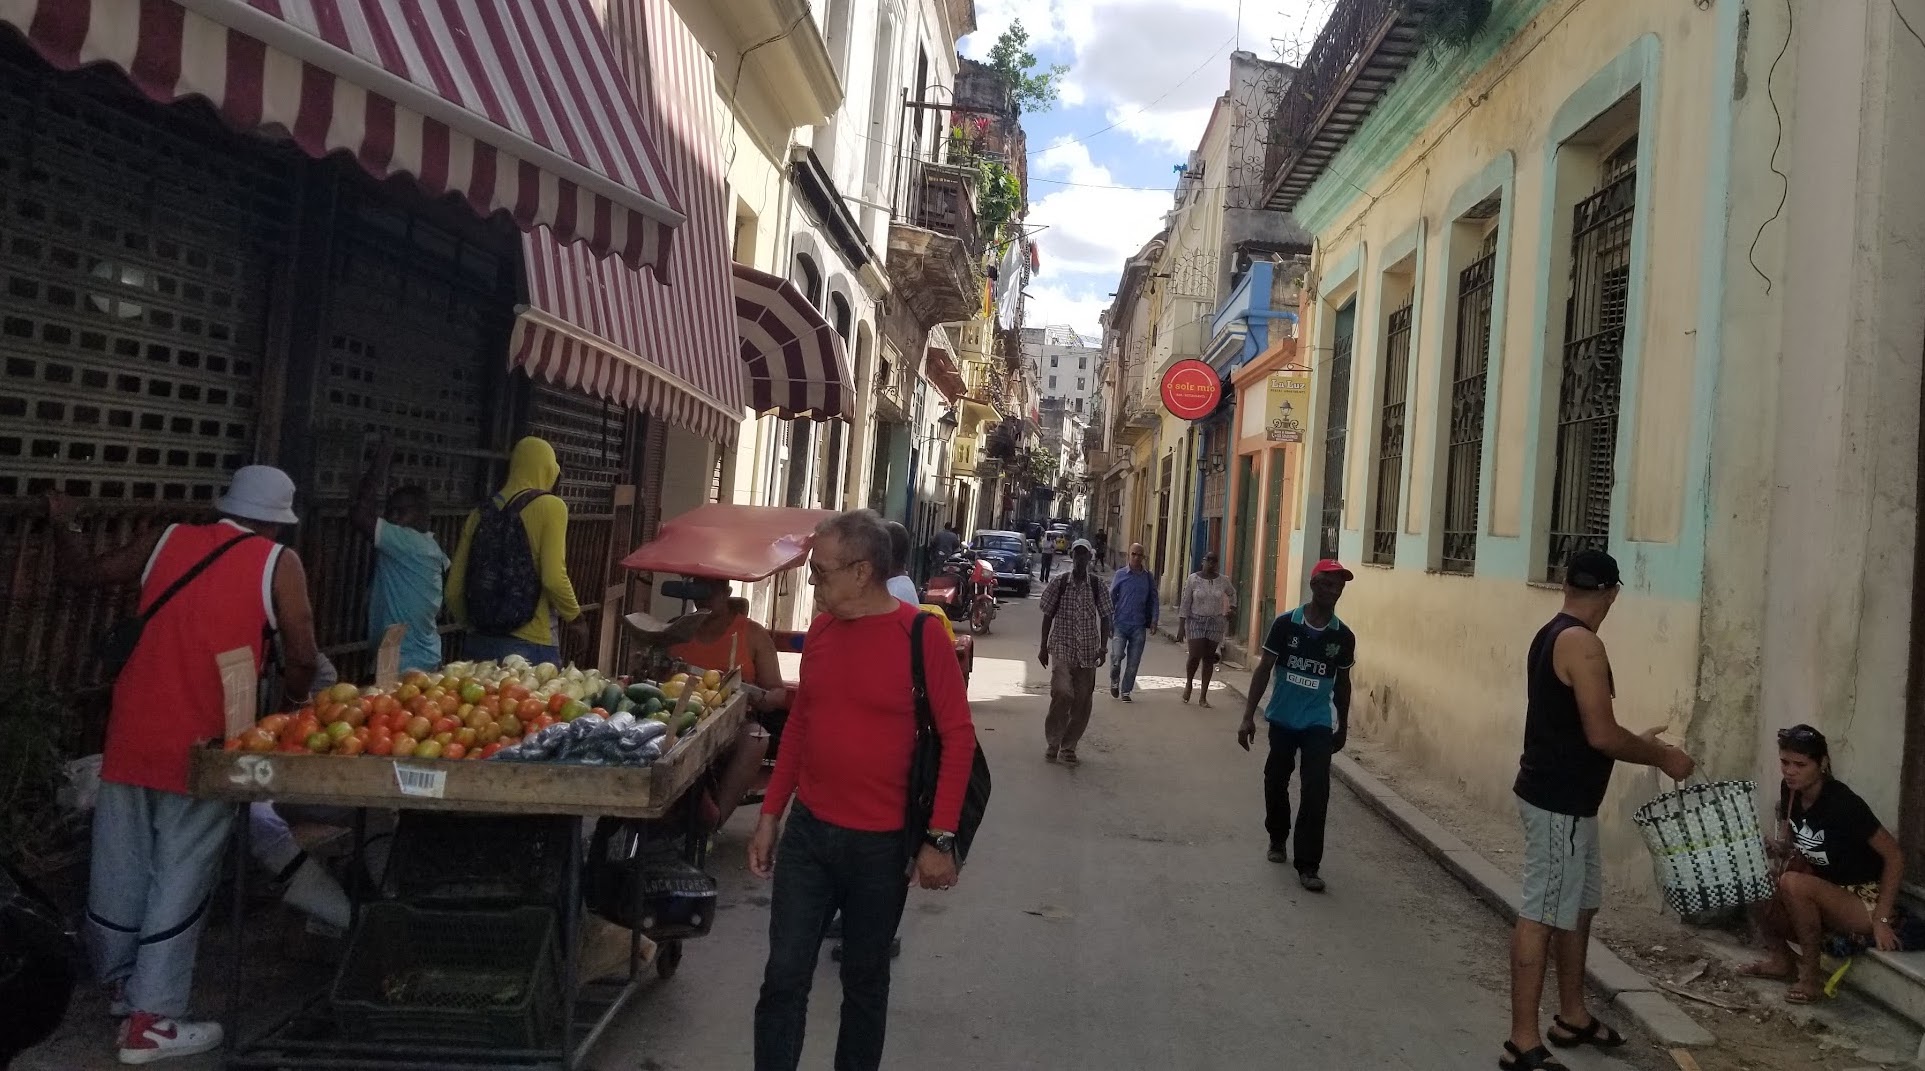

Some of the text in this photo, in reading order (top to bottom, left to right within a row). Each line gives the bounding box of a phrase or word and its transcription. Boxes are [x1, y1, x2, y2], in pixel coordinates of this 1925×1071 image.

[1271, 379, 1305, 389] La Luz
[1288, 674, 1319, 688] GUIDE
